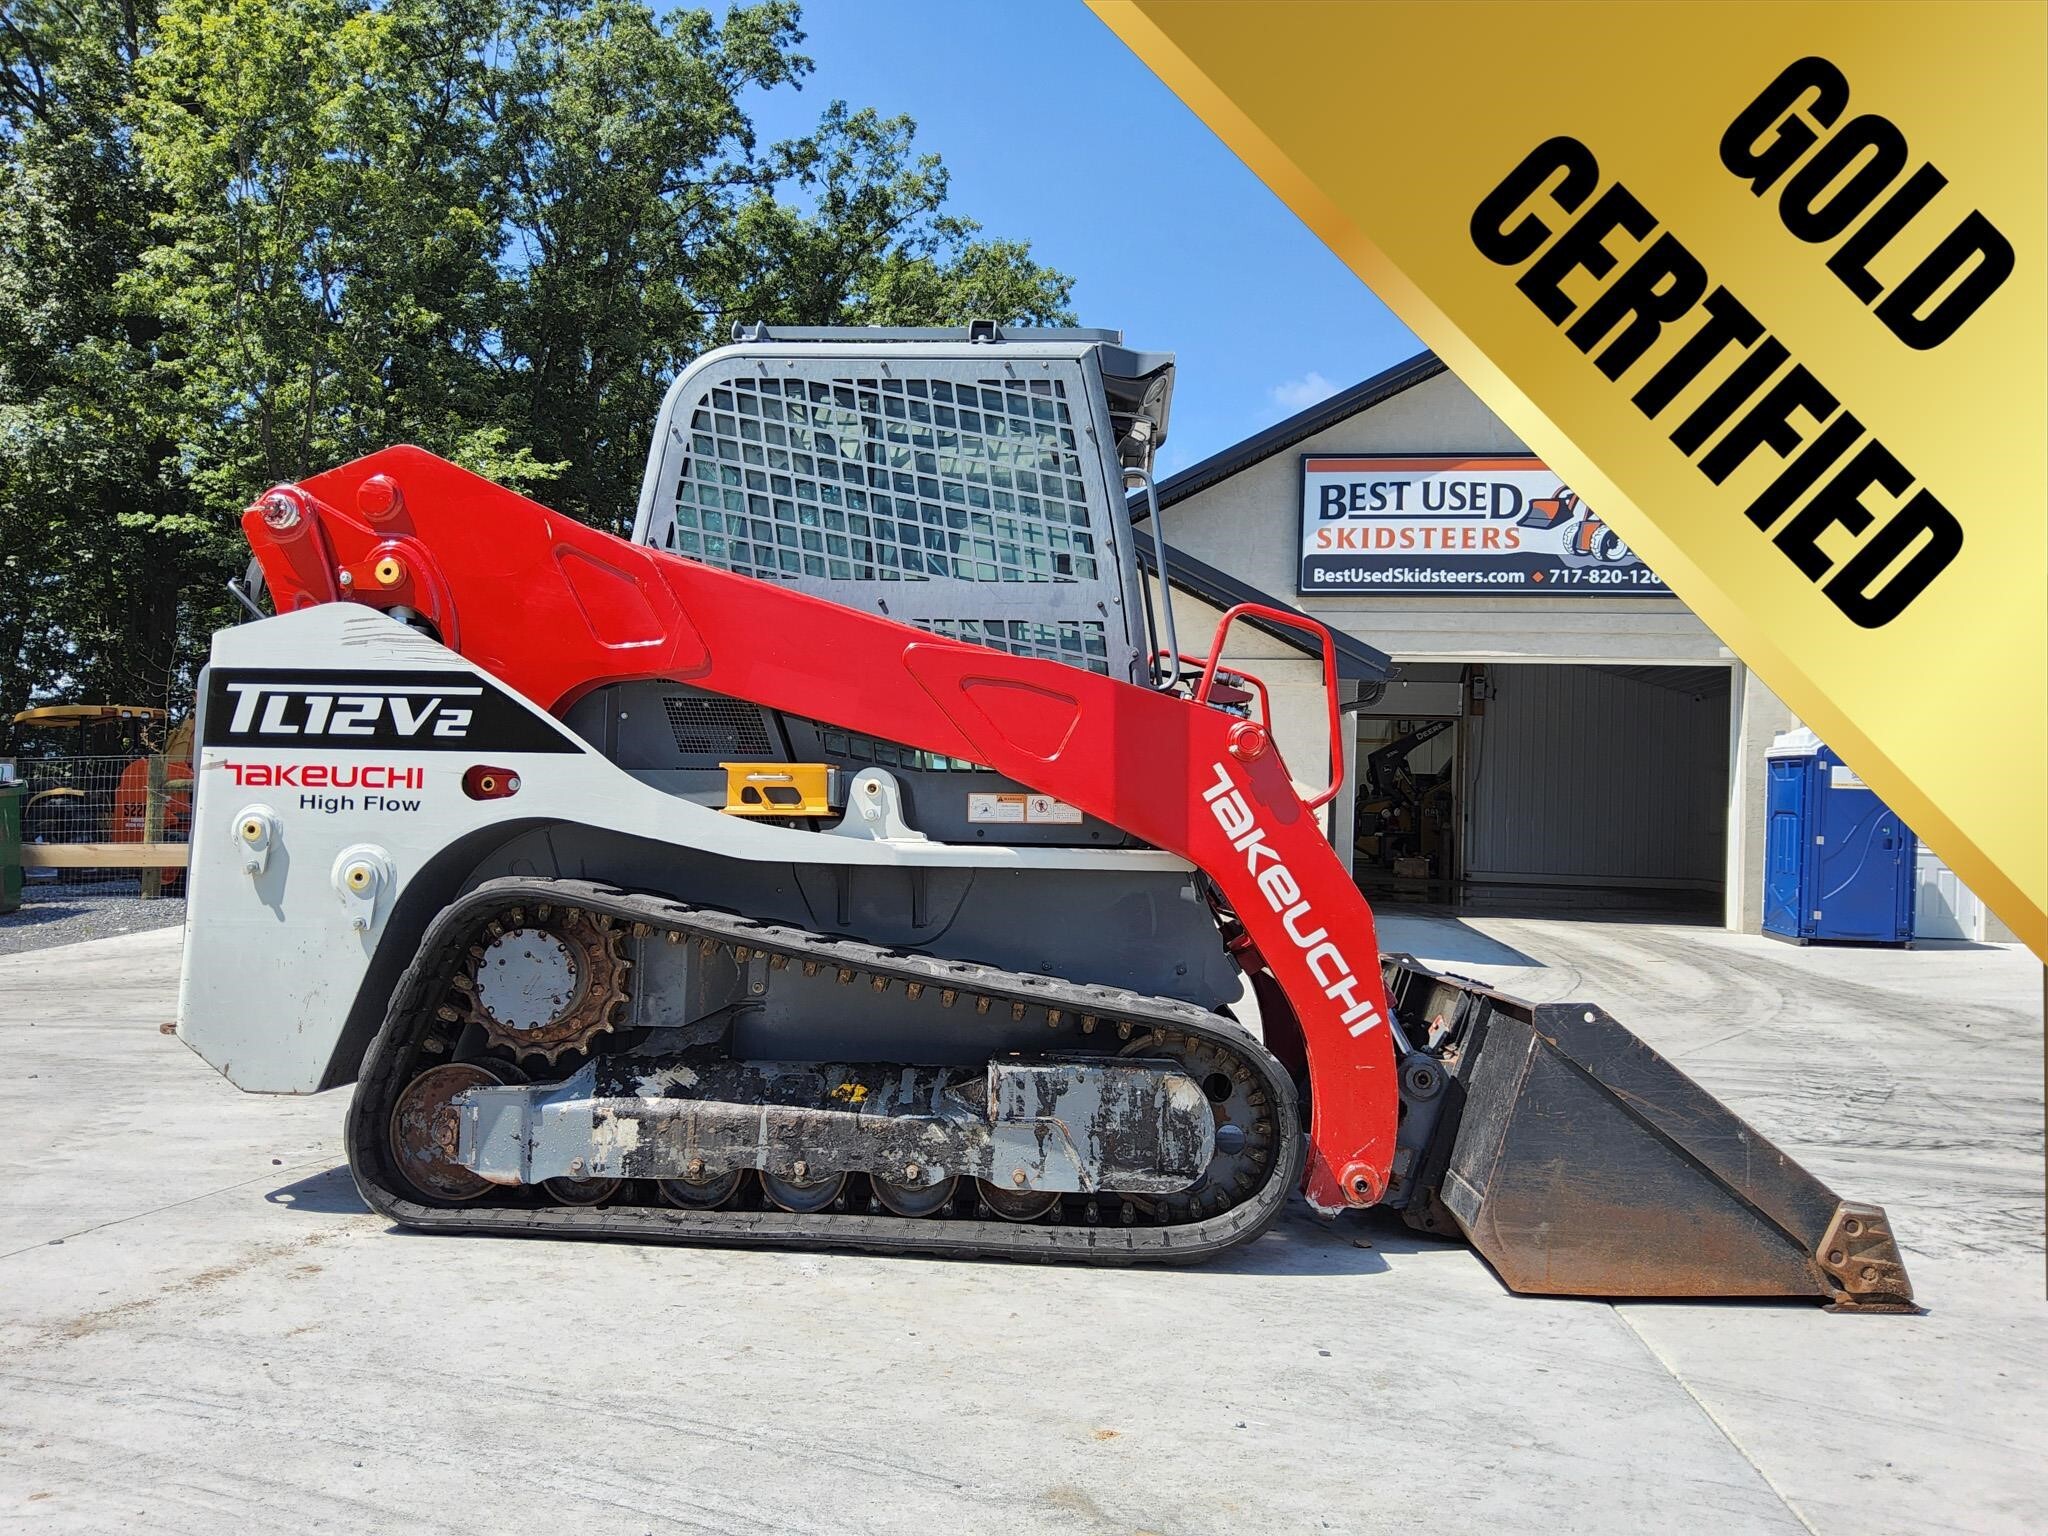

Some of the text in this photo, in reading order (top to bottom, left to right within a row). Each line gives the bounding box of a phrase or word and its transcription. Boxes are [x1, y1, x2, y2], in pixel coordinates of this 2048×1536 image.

[1319, 481, 1523, 520] BEST USED
[1316, 527, 1521, 550] SKIDSTEERS
[1313, 567, 1662, 585] BestUsedSkidsteers.com 717-820-126
[226, 683, 483, 737] TL12V2
[299, 794, 421, 814] High Flow
